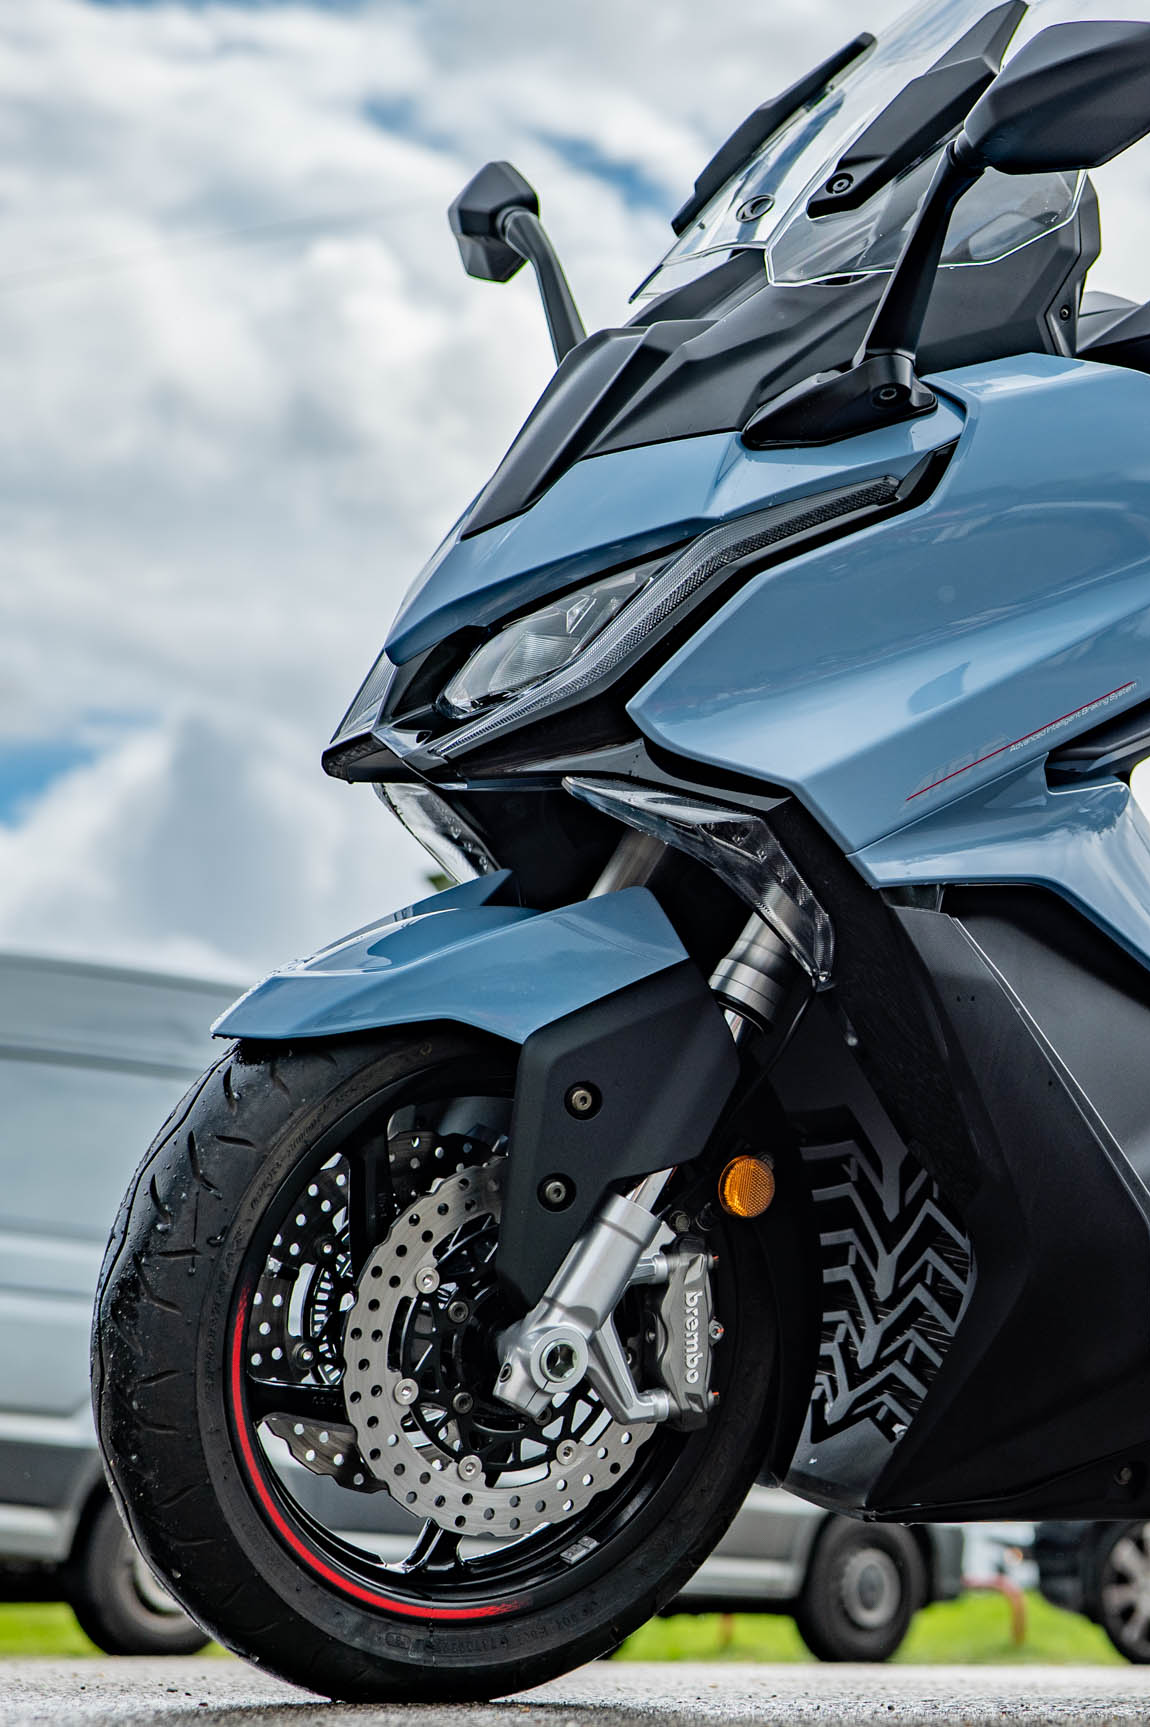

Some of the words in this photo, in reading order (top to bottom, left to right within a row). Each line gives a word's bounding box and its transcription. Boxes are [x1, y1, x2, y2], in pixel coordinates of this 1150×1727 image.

[1009, 727, 1047, 752] Advanced
[1081, 698, 1109, 716] Braking
[1109, 682, 1137, 701] System
[686, 1290, 703, 1383] brembo
